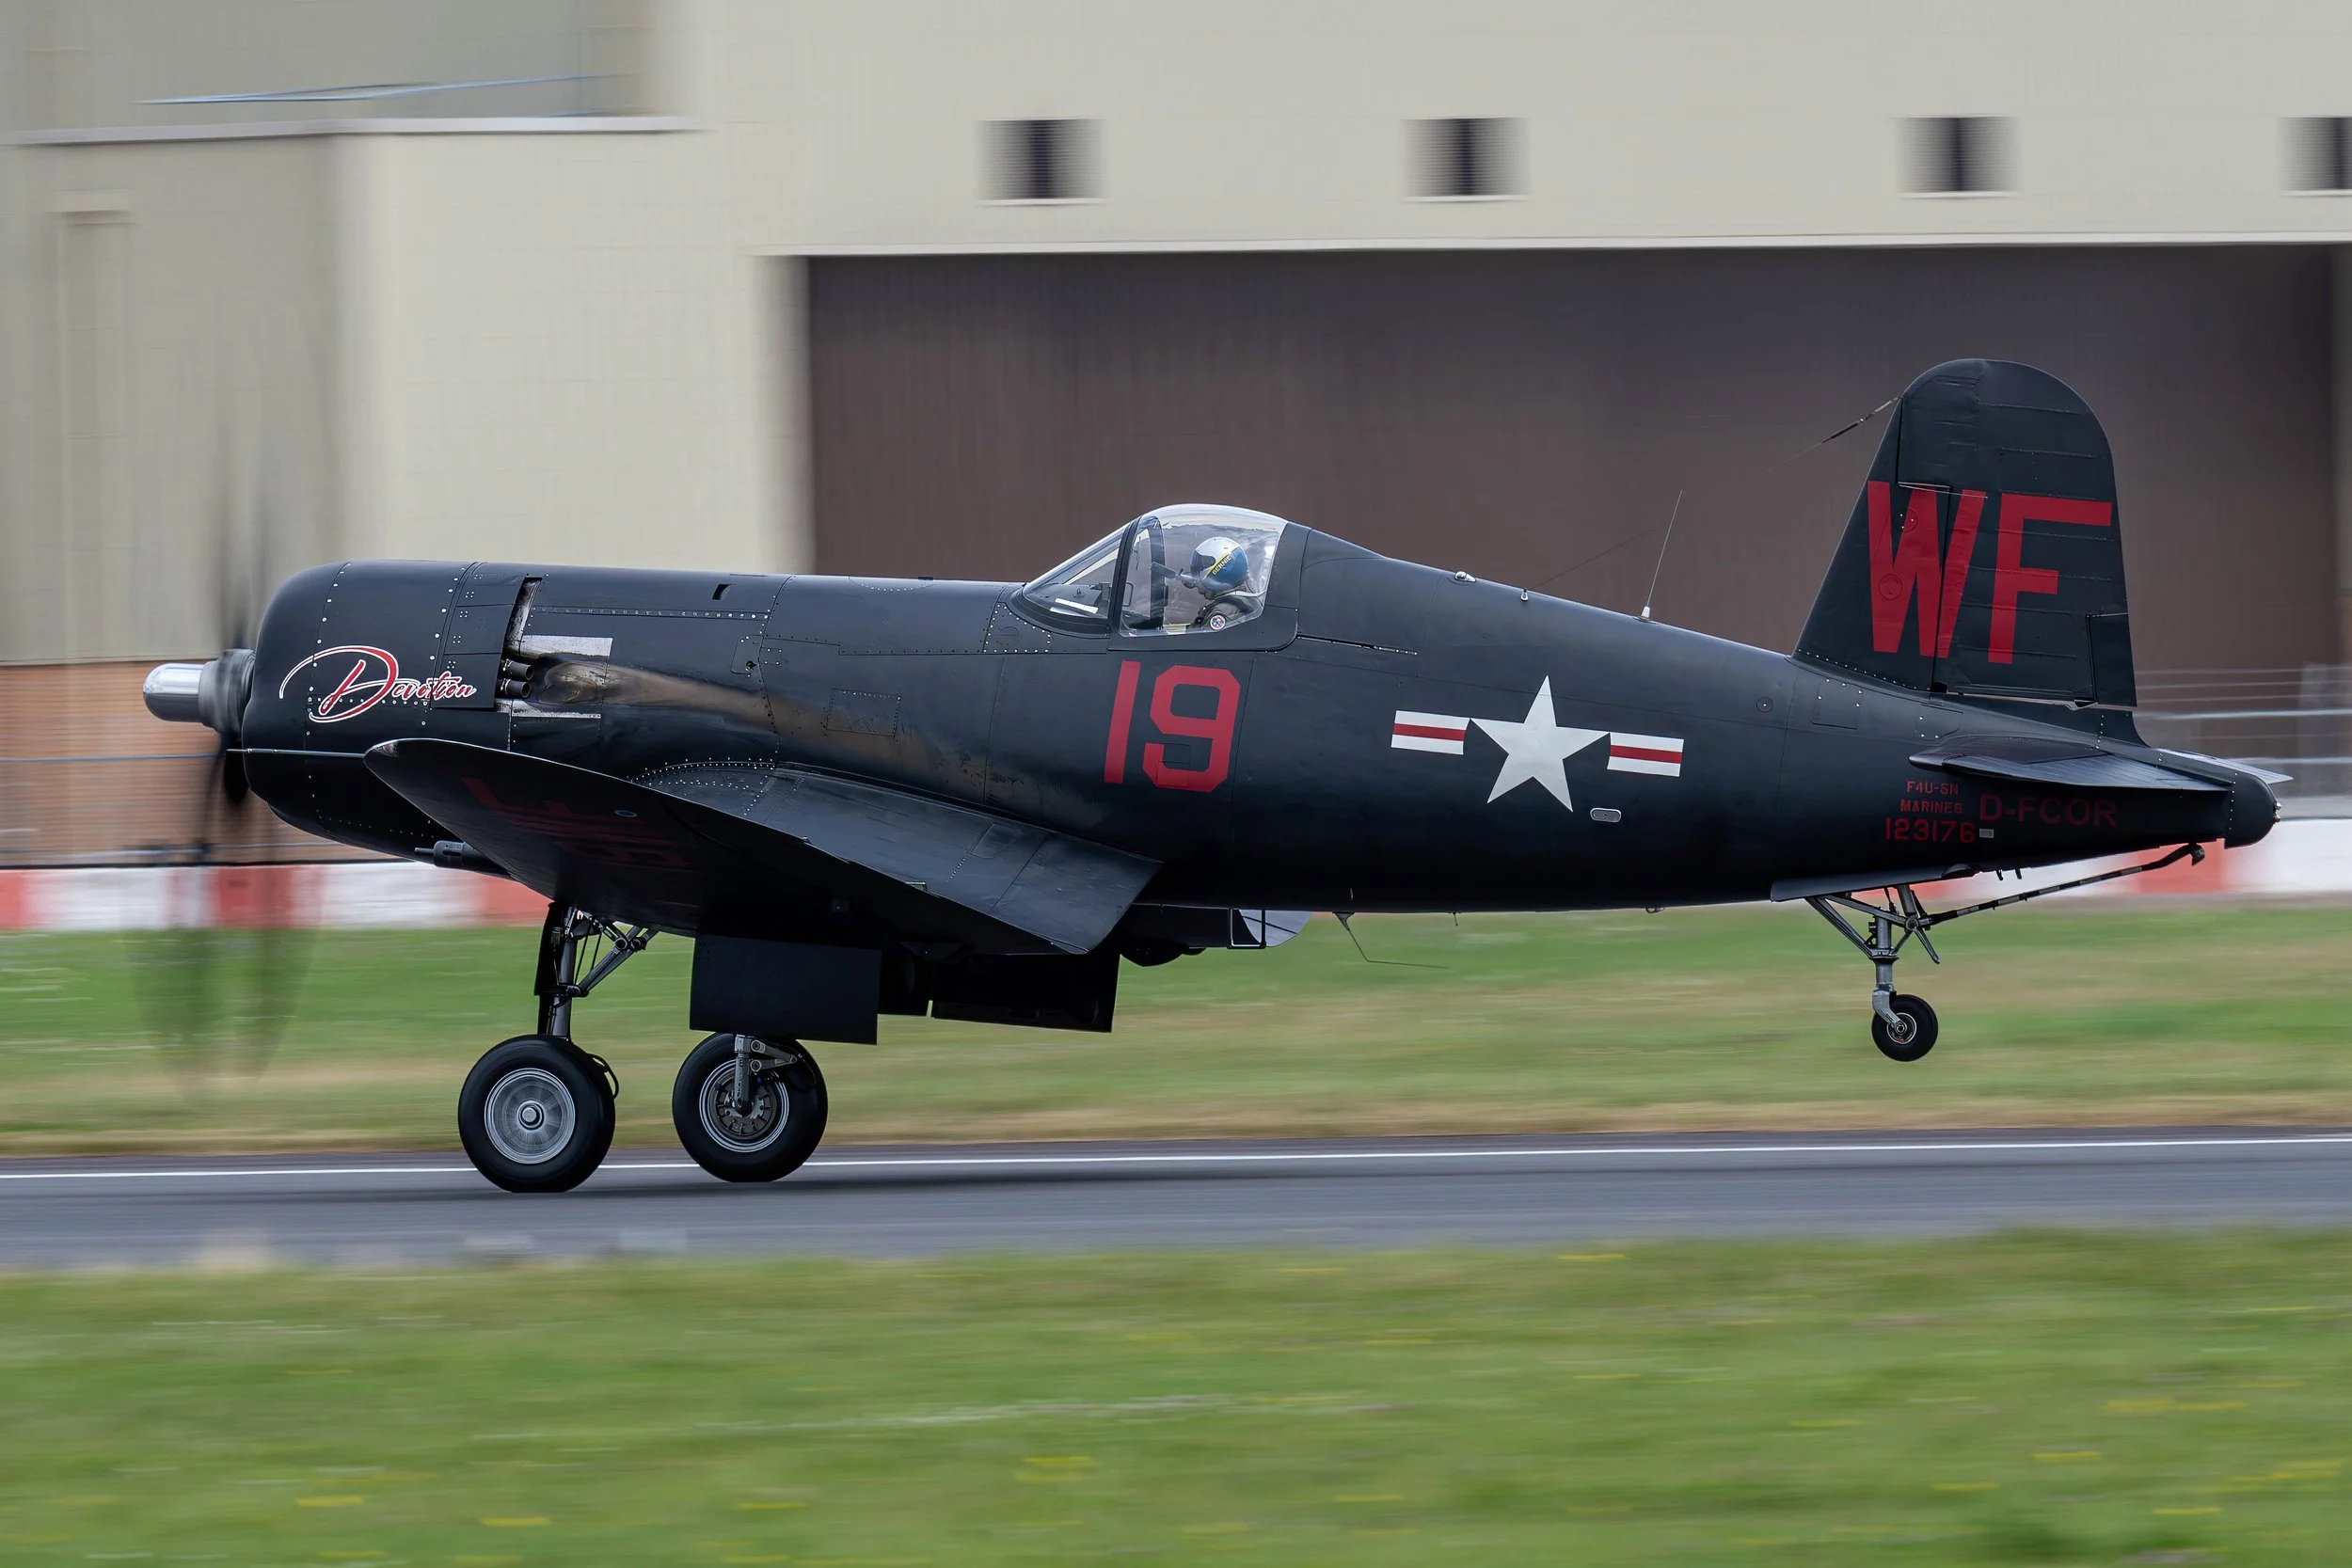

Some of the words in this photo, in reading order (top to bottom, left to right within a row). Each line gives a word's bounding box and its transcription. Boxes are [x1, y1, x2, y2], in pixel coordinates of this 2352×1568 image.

[1867, 481, 2112, 664] WF
[279, 645, 477, 722] Devotion
[1104, 660, 1241, 792] 19
[1885, 816, 1976, 844] 123176
[1900, 800, 1963, 815] MARINES
[1979, 794, 2117, 828] D-FCOR
